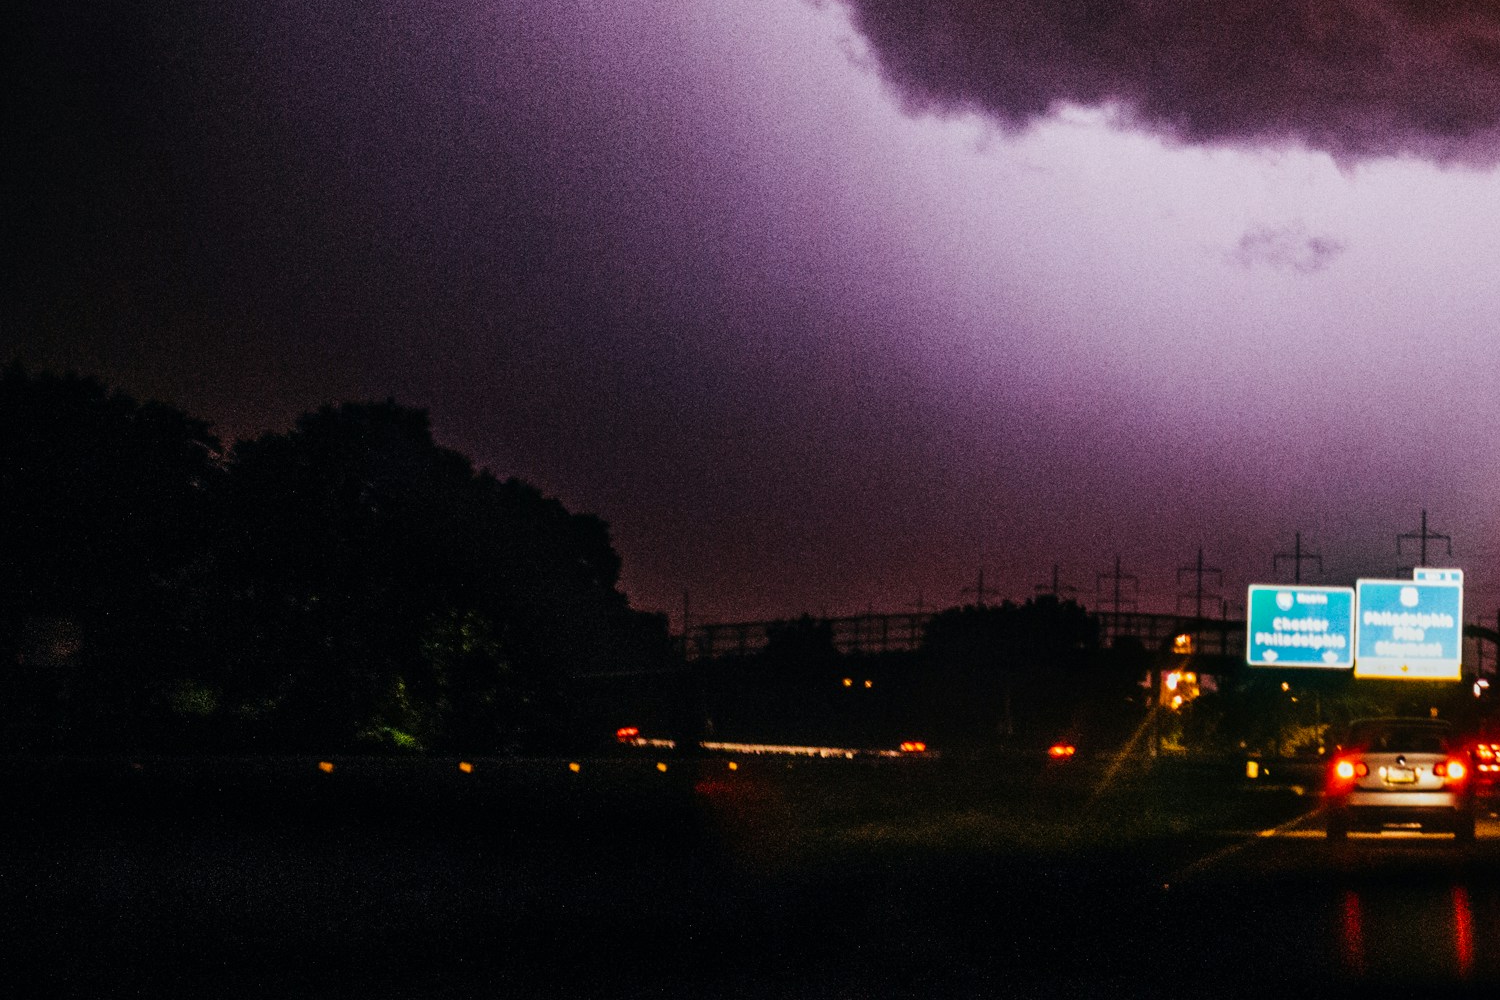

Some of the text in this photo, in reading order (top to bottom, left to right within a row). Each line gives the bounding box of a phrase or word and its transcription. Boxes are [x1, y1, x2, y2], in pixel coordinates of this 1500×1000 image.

[1273, 617, 1329, 631] Chester
[1363, 611, 1454, 630] Philadelphia
[1255, 632, 1346, 649] Philadelphia
